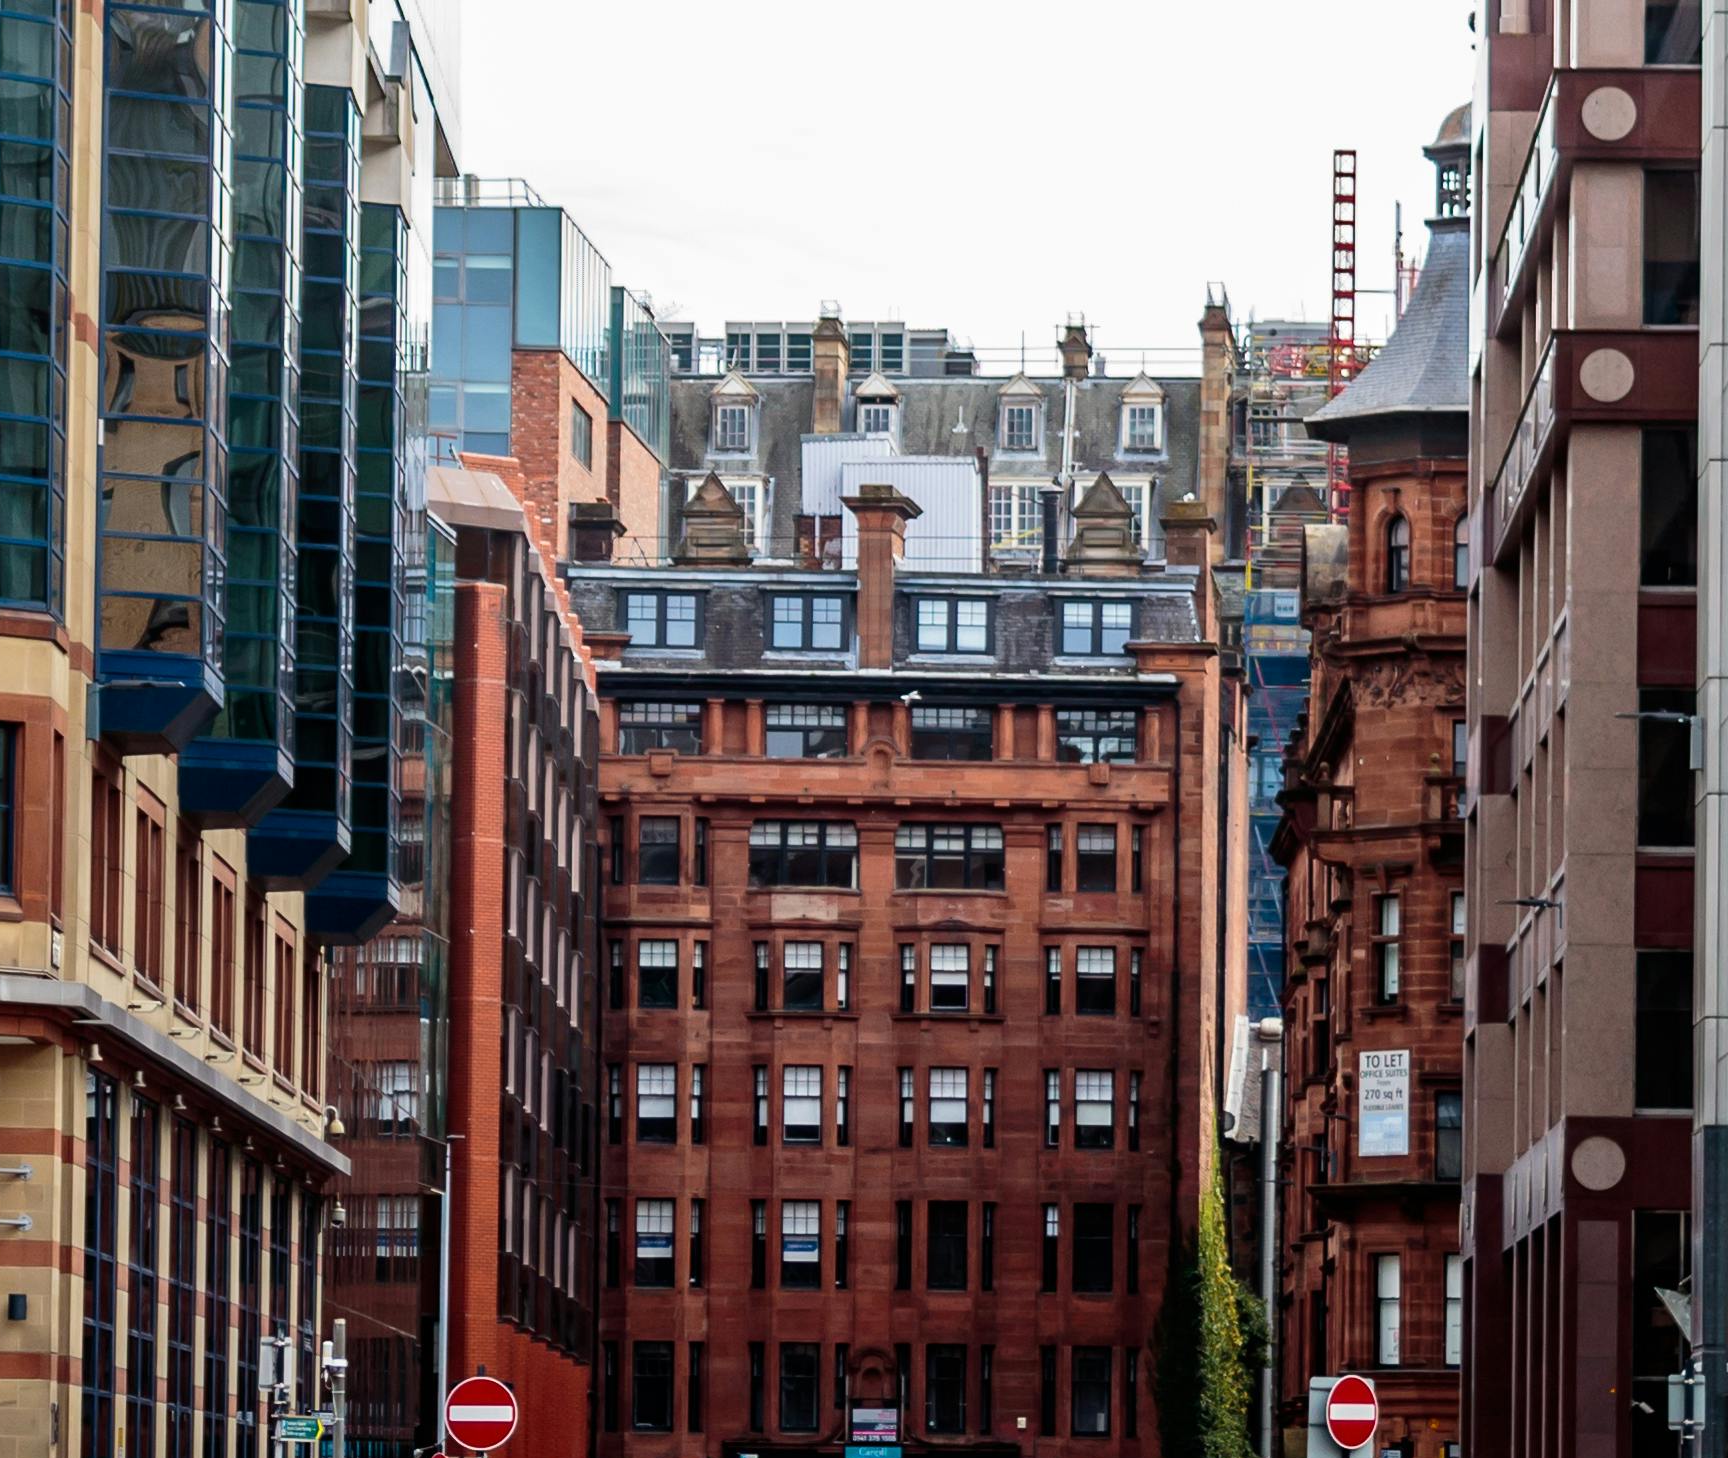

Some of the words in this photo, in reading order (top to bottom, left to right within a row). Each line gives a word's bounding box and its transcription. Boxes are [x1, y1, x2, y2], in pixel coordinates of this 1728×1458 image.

[1365, 1054, 1380, 1068] TO
[1384, 1053, 1403, 1068] LET
[1360, 1070, 1383, 1079] OFFICE
[1385, 1069, 1408, 1078] SUITES
[1364, 1089, 1381, 1100] 270
[1383, 1090, 1393, 1101] sq
[1395, 1088, 1403, 1098] ft
